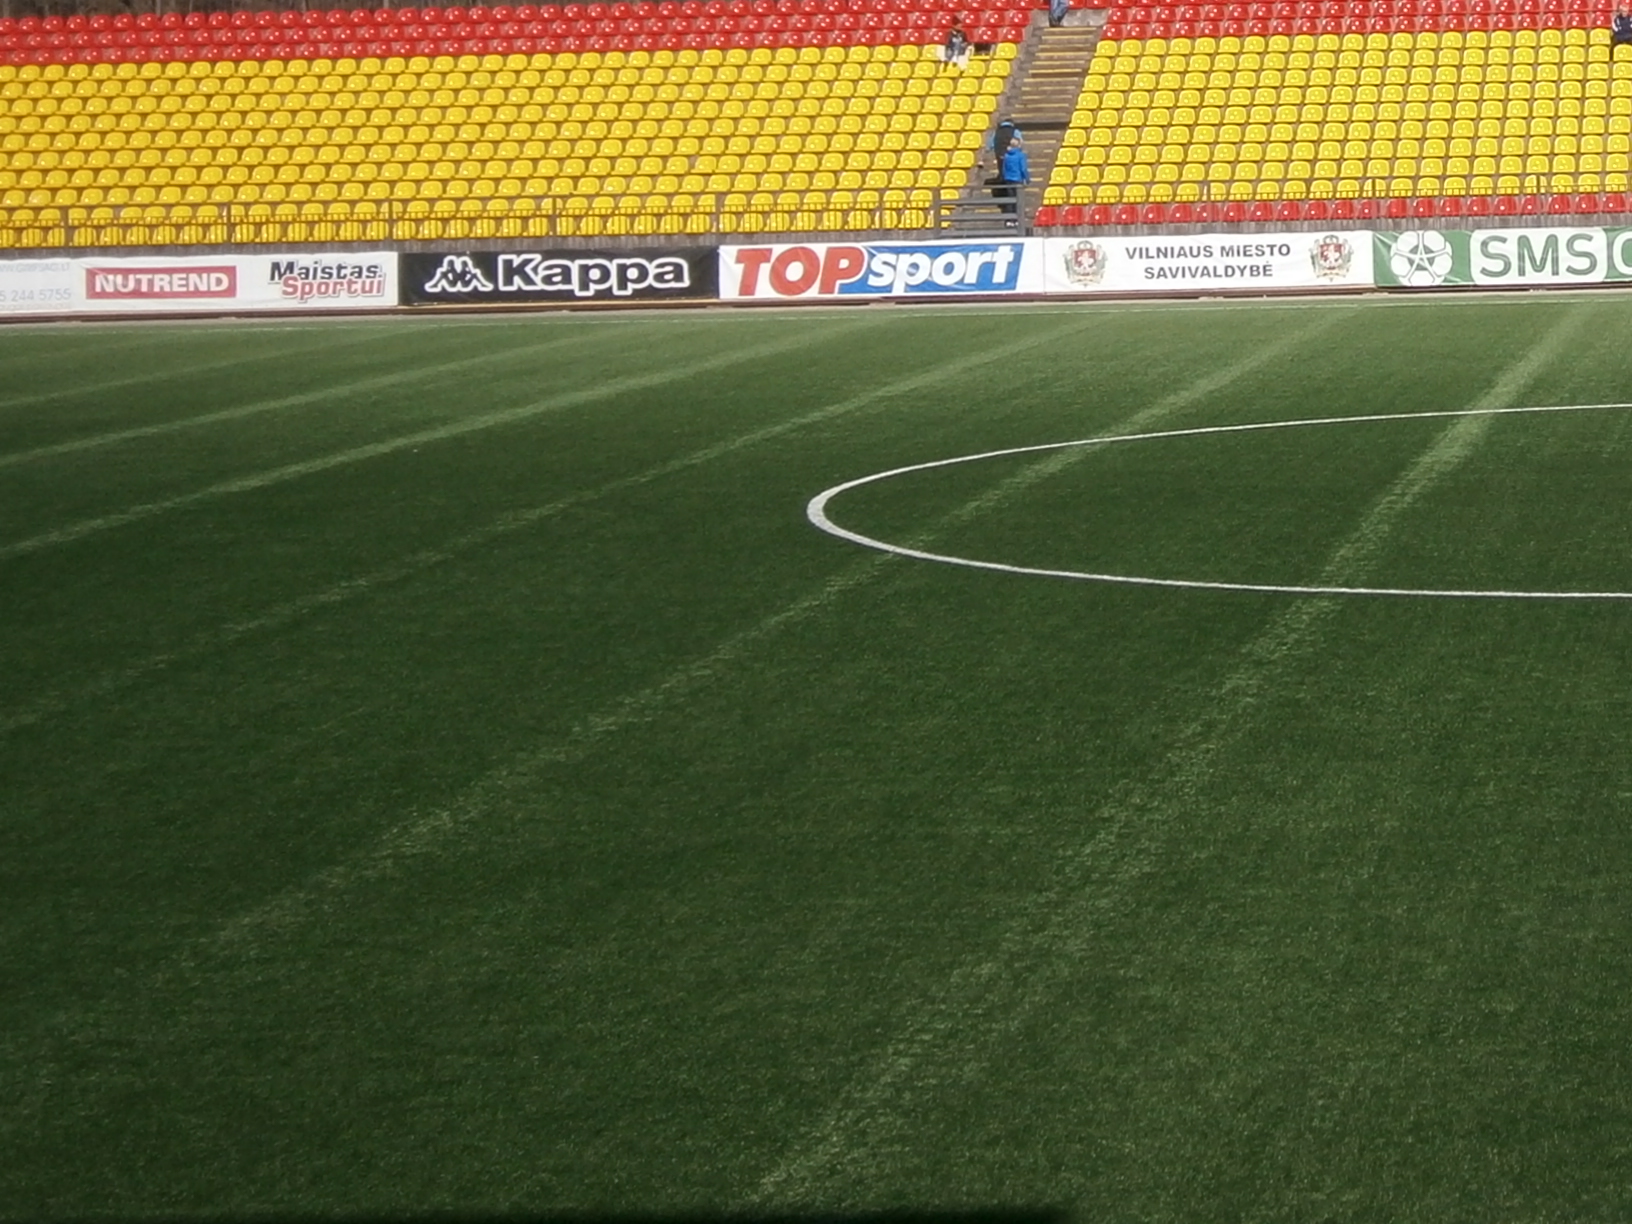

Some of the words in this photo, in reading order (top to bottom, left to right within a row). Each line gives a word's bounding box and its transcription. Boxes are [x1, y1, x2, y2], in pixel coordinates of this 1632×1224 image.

[1125, 245, 1214, 259] VILNIAUS
[1220, 243, 1291, 258] MIESTO
[269, 261, 380, 281] Maistas
[498, 254, 690, 296] Kappa
[1144, 261, 1273, 279] SAVIVALDYBĖ
[94, 273, 230, 293] NUTREND
[280, 277, 385, 301] Sportui
[11, 289, 35, 302] 244
